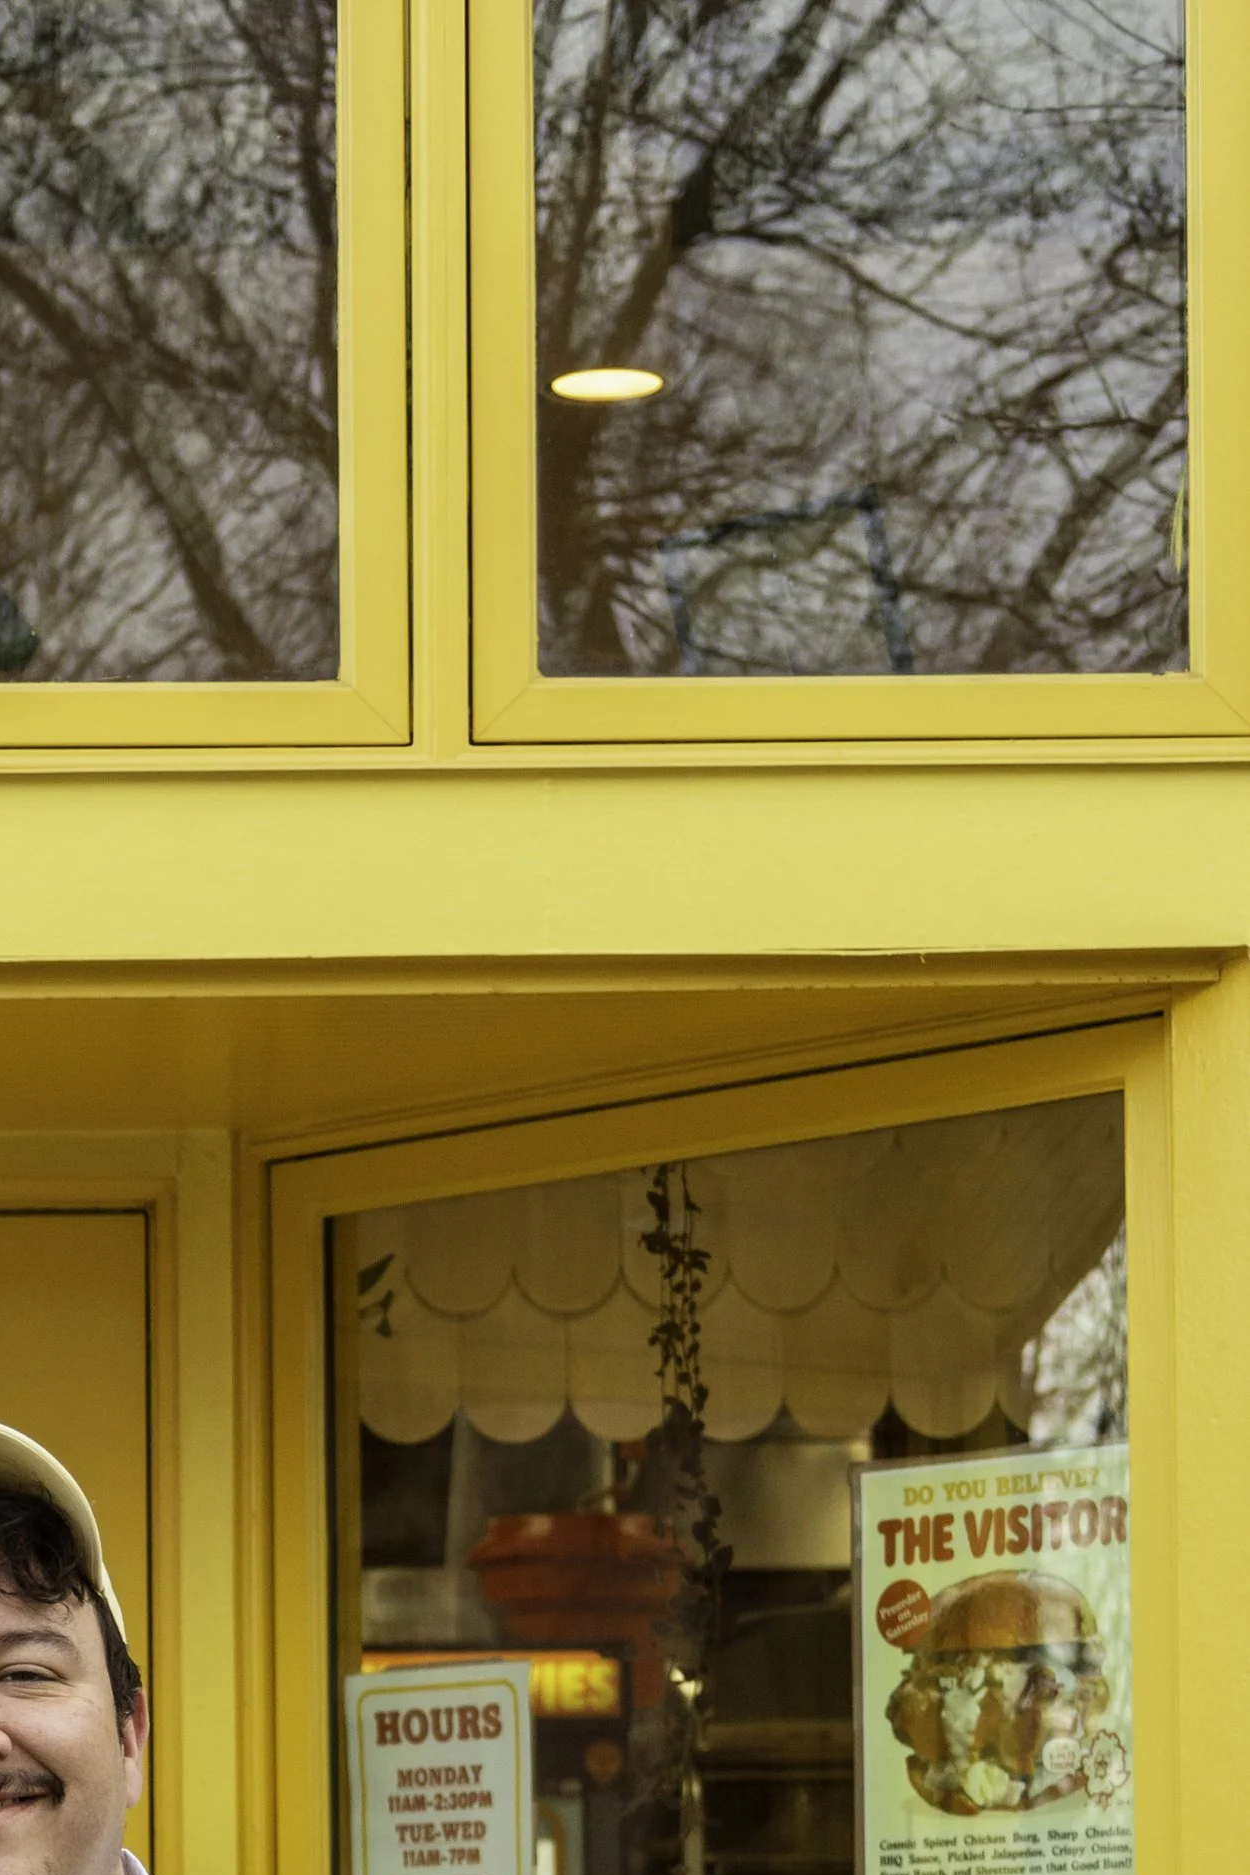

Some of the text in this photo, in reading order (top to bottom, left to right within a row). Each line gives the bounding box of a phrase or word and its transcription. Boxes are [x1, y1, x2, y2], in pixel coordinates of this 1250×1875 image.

[904, 1485, 934, 1506] DO
[942, 1480, 987, 1500] YOU
[877, 1495, 1128, 1567] THE VISITOR
[375, 1703, 502, 1746] HOURS
[397, 1765, 483, 1788] MONDAY
[395, 1820, 487, 1843] TUE-WED
[963, 1834, 1006, 1846] Chicken
[1047, 1829, 1078, 1842] Sharp
[948, 1850, 985, 1863] Pickled
[1052, 1844, 1085, 1858] Crispy
[1046, 1861, 1067, 1873] that
[1071, 1859, 1099, 1871] Good
